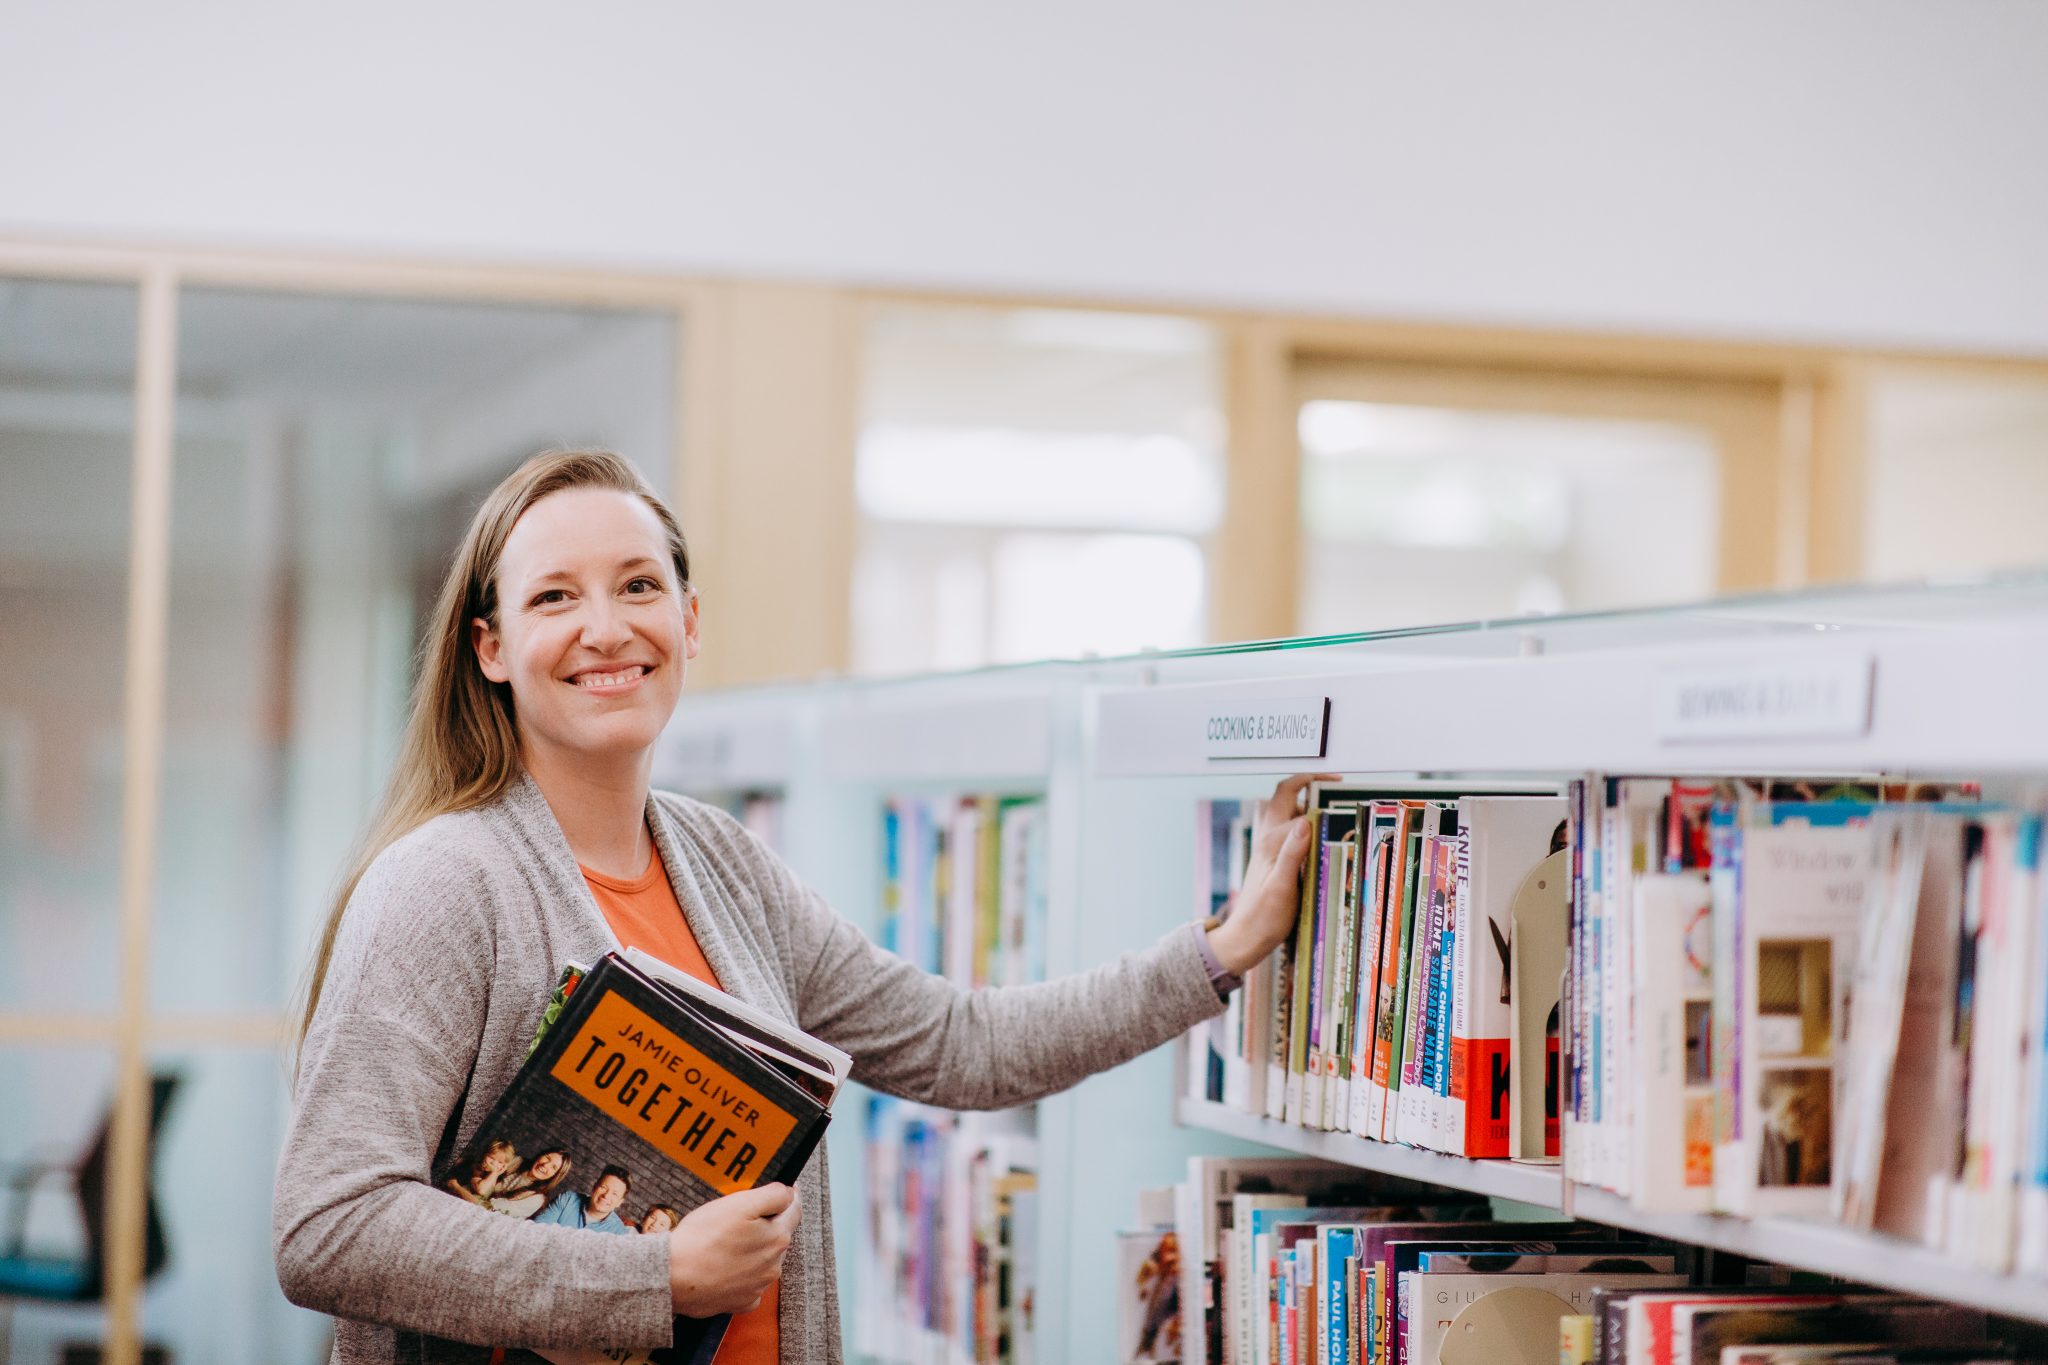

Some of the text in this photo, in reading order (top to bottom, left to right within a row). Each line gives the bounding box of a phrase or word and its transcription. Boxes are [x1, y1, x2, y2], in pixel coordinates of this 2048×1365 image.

[1207, 714, 1308, 740] COOKING & BAKING
[1457, 825, 1470, 889] KNIFE
[1372, 923, 1381, 968] SPICY
[1427, 904, 1436, 941] Vegetable
[1408, 895, 1428, 1042] ADVENTURES VEGGIELAND
[1419, 944, 1432, 1012] Garden
[1422, 905, 1443, 1086] HOME SAUSAGE MAKIN
[1456, 970, 1465, 996] MEALS
[1413, 1016, 1427, 1085] Cookbo
[1437, 991, 1446, 1051] CHICKEN
[617, 1022, 760, 1128] JAMIE OLIVER
[1436, 1052, 1443, 1062] &
[575, 1035, 758, 1183] TOGETHER
[1332, 1280, 1341, 1324] PAUL
[1436, 1291, 1476, 1304] GIU
